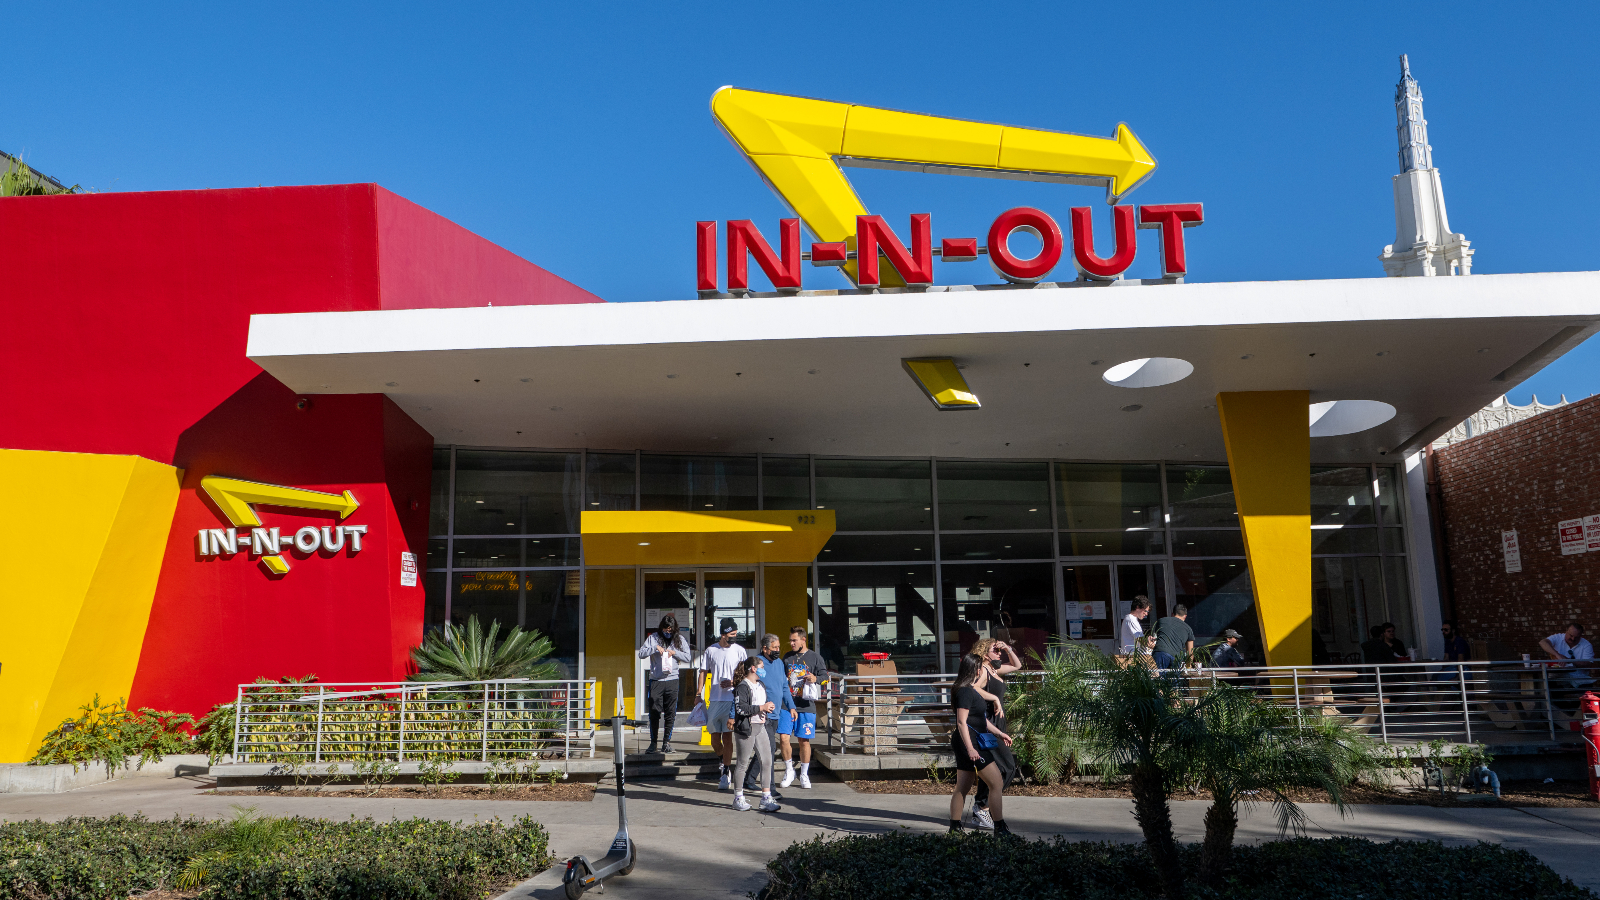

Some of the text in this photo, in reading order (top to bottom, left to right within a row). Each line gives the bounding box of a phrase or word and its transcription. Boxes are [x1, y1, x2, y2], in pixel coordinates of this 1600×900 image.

[1411, 103, 1425, 166] FOX
[697, 202, 1204, 292] IN-N-OUT
[798, 515, 815, 524] 922
[198, 525, 368, 556] IN-N-OUT
[460, 580, 533, 594] you can tate
[475, 571, 517, 583] Quality
